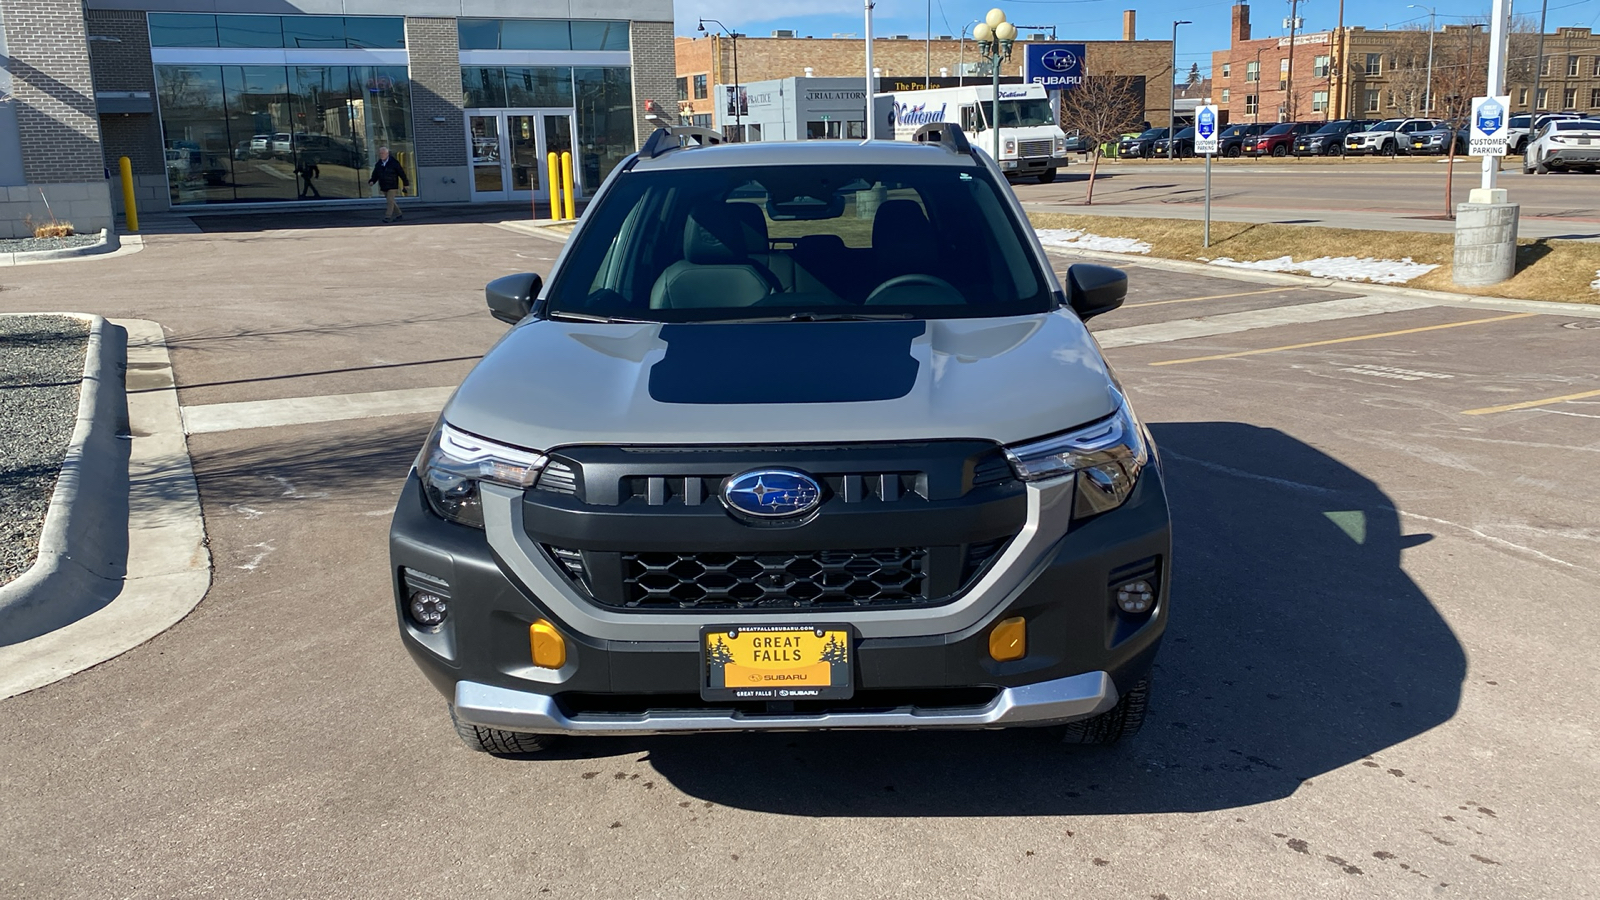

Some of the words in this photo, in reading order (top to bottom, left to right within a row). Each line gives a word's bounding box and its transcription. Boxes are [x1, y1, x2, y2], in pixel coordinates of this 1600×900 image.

[1033, 76, 1081, 84] SUBARU
[895, 82, 909, 91] The
[747, 93, 771, 103] PRACTICE
[889, 101, 947, 126] National
[753, 637, 801, 648] GREAT
[753, 650, 802, 661] FALLS
